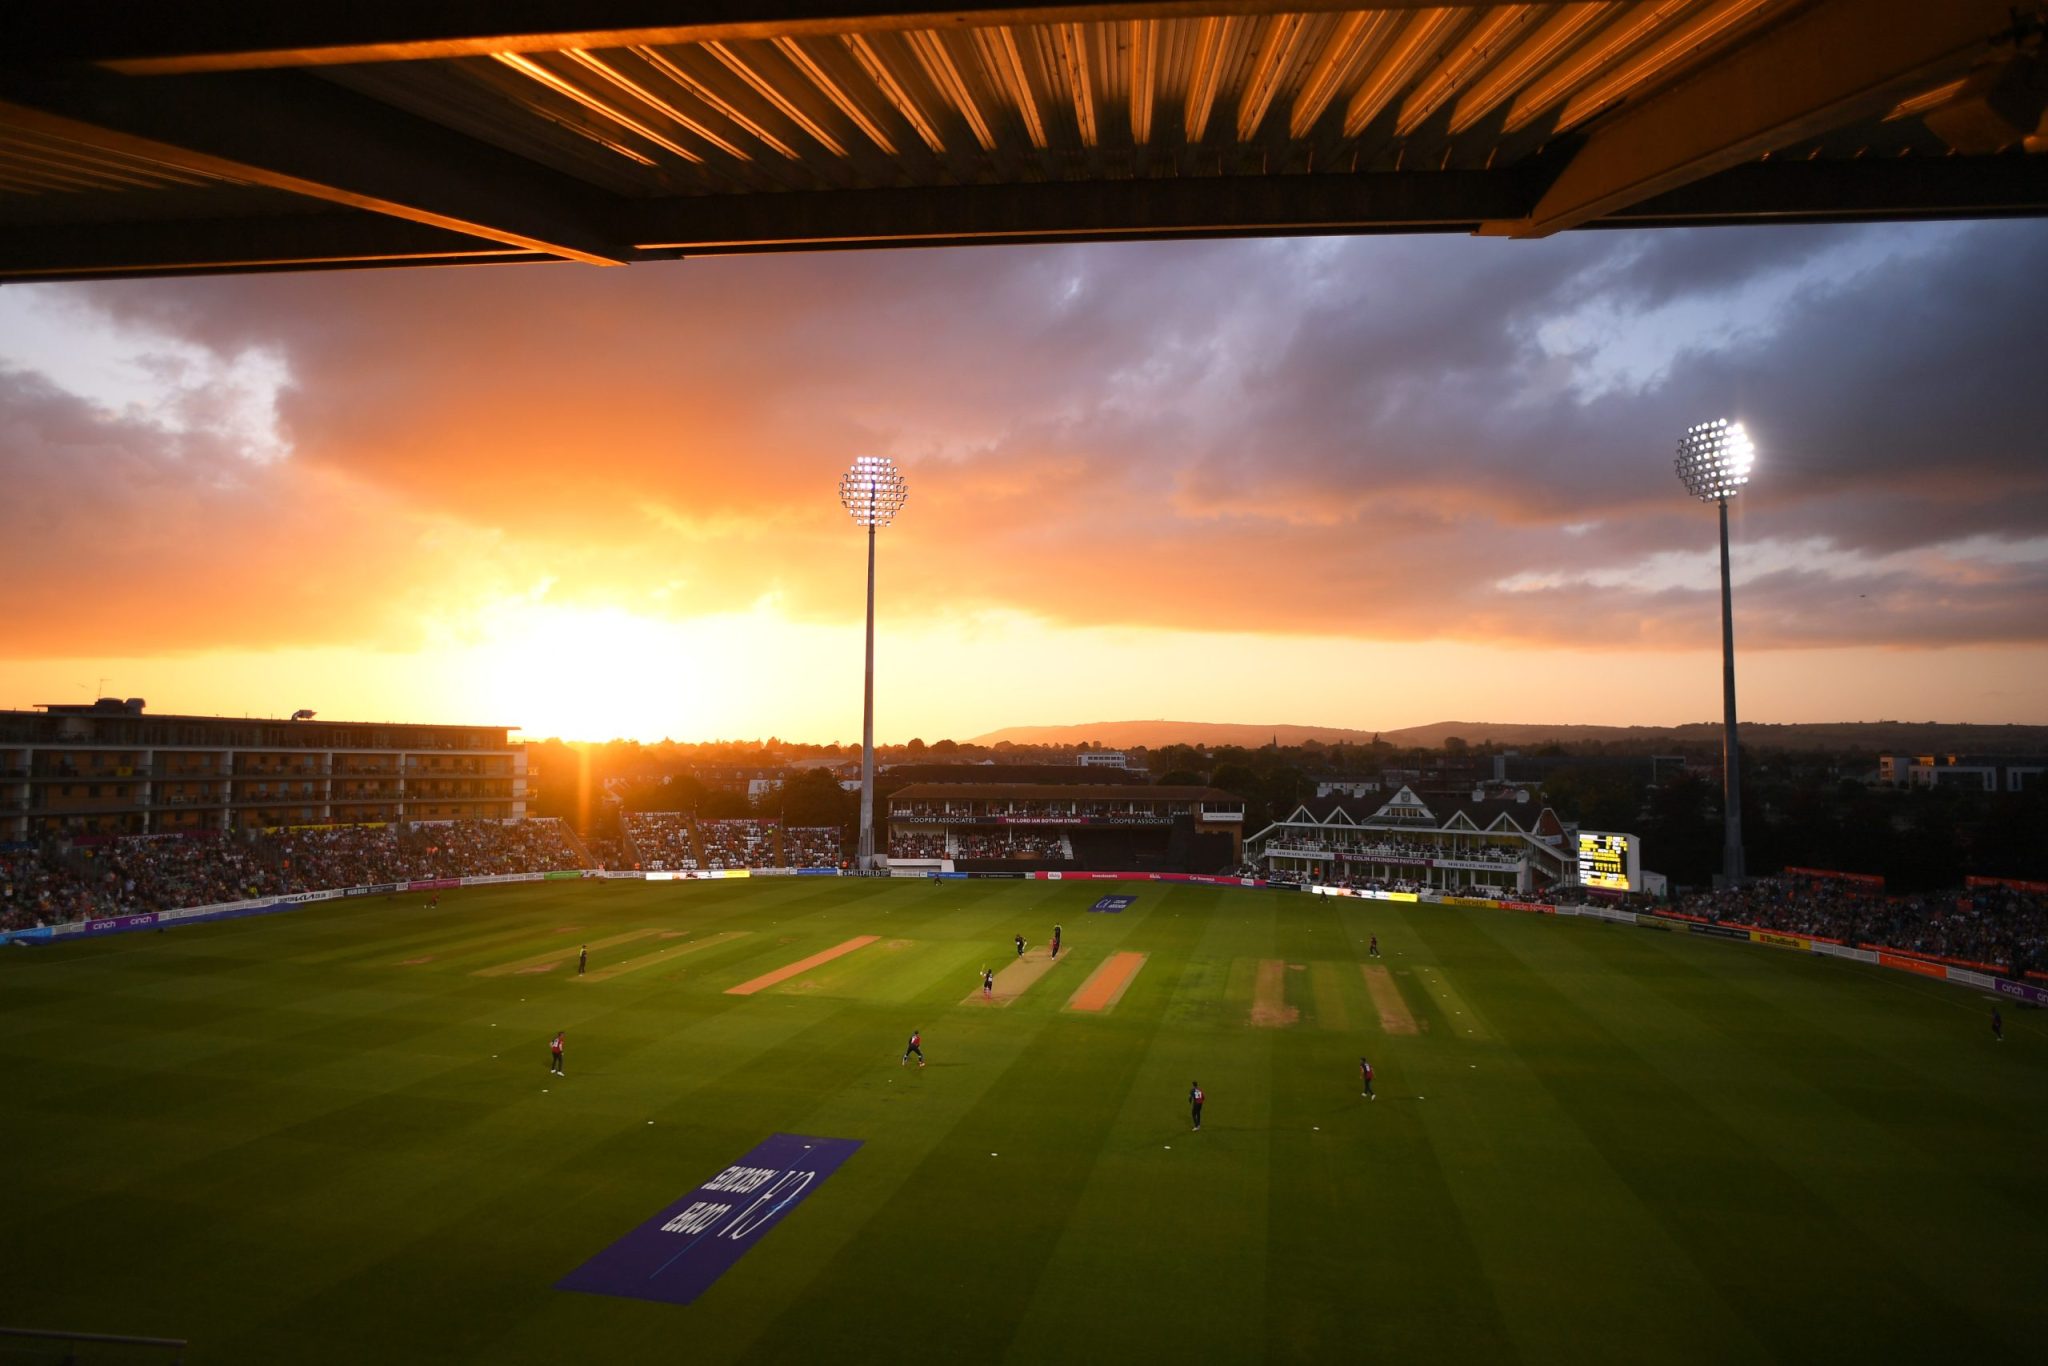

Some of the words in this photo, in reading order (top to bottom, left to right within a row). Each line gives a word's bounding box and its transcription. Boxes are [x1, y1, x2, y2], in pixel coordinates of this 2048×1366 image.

[1509, 902, 1528, 910] Trade
[1529, 904, 1553, 913] Nation
[93, 921, 116, 930] cinch
[130, 916, 152, 926] cinch
[2002, 984, 2024, 996] cinch
[660, 1201, 732, 1235] COOPER
